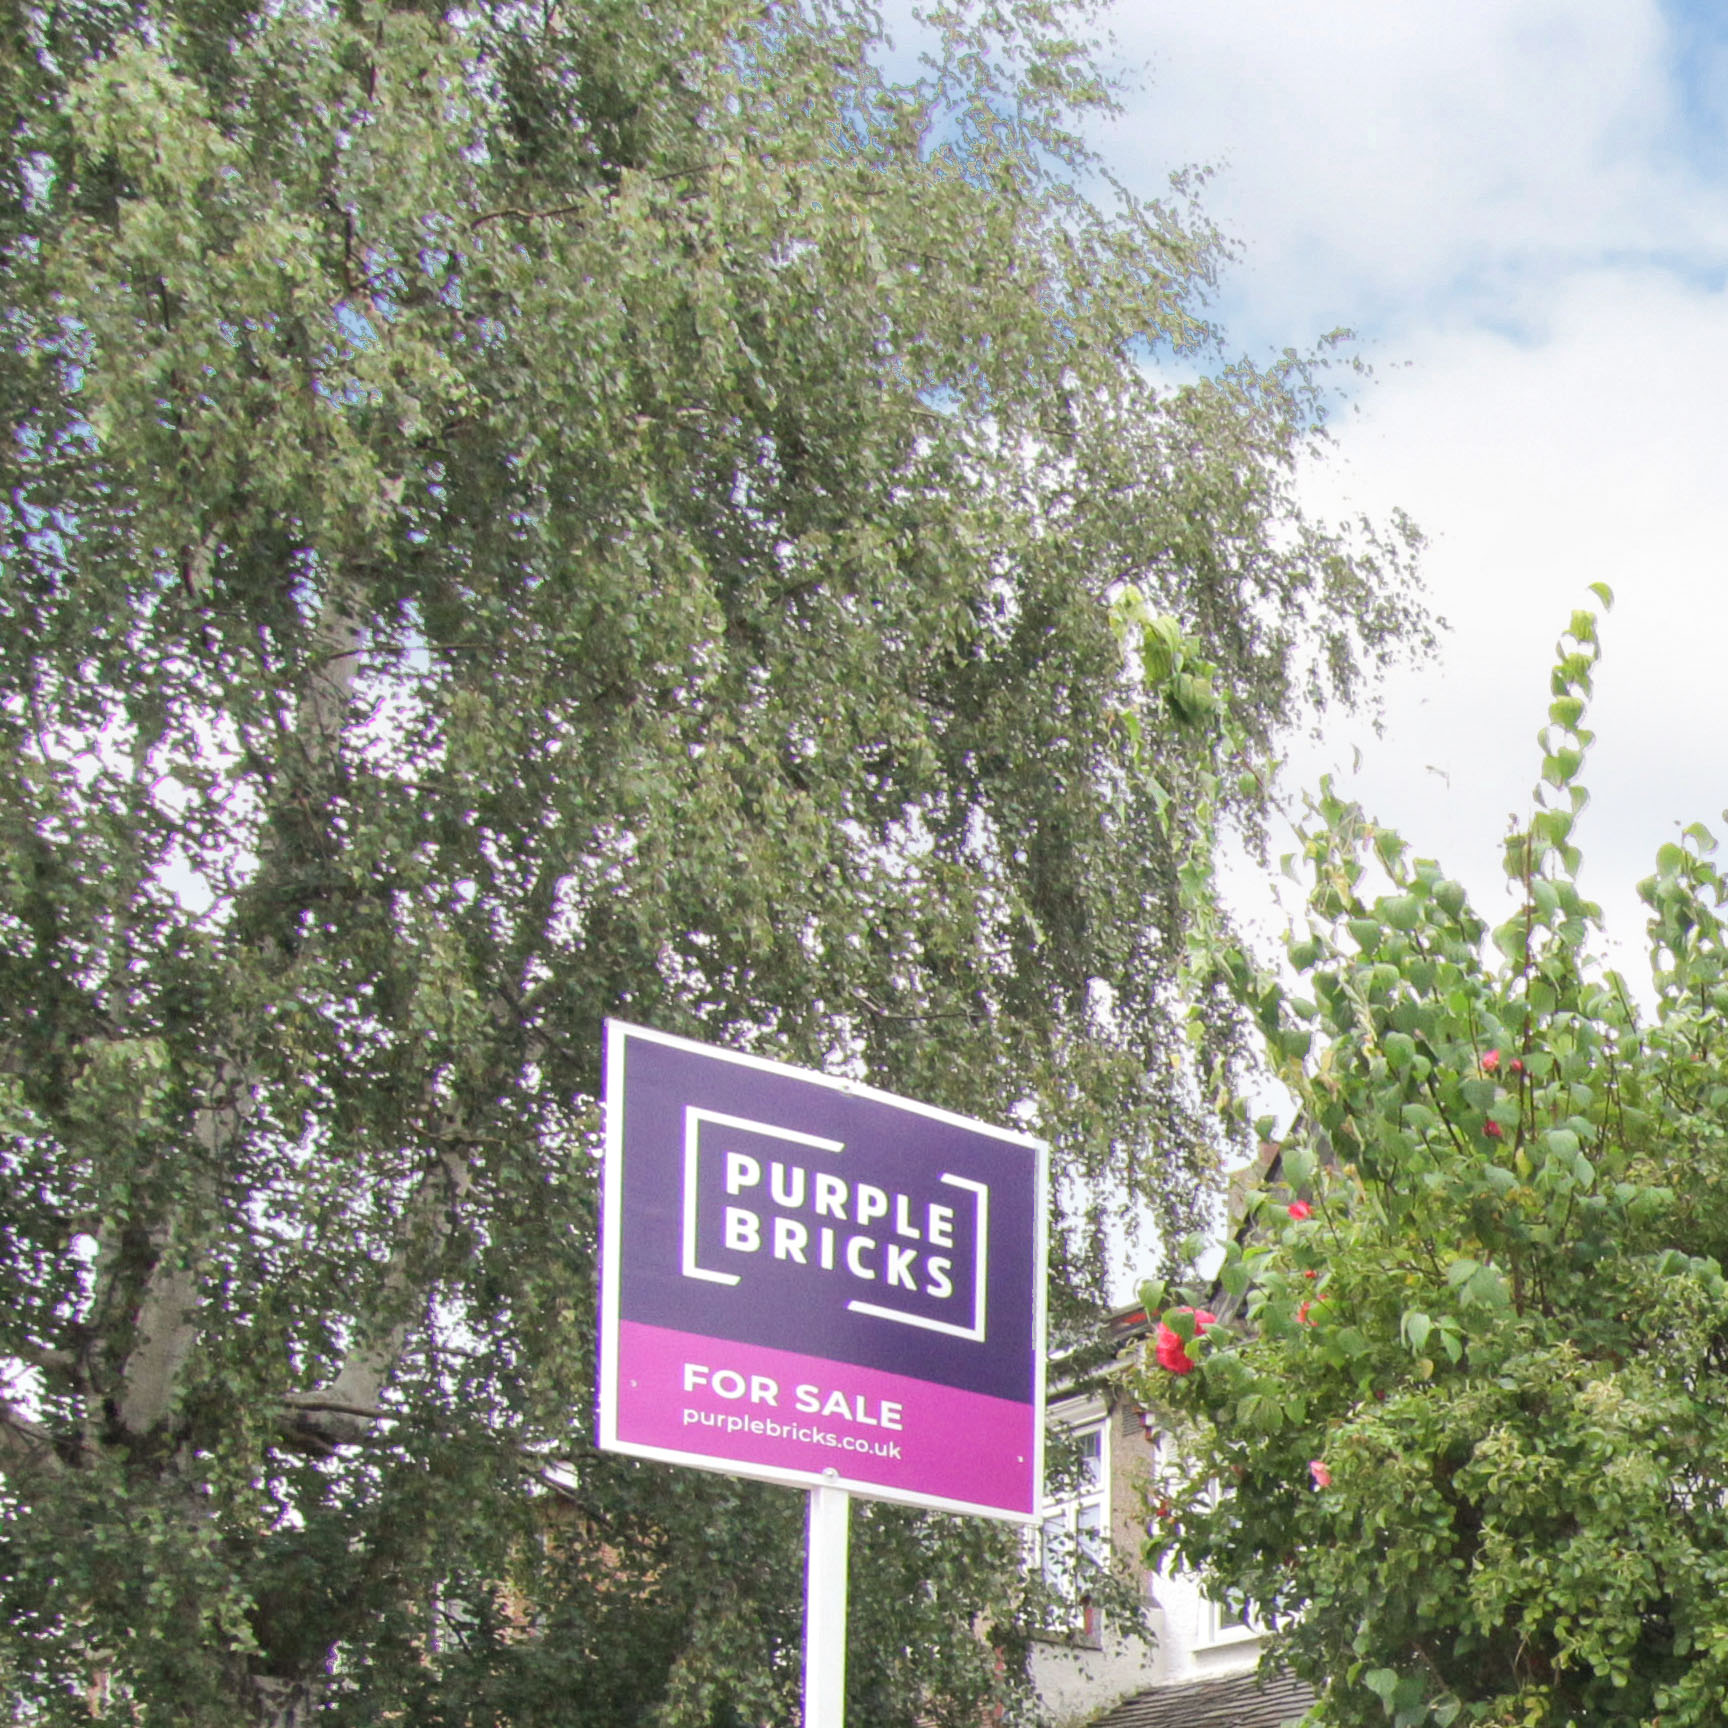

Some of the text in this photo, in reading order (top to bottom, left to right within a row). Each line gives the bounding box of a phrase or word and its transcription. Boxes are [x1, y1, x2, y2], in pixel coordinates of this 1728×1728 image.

[724, 1151, 954, 1249] PURPLE
[723, 1206, 953, 1299] BRICKS
[682, 1406, 902, 1460] purplebricks.co.uk
[683, 1362, 904, 1431] FOR SALE
